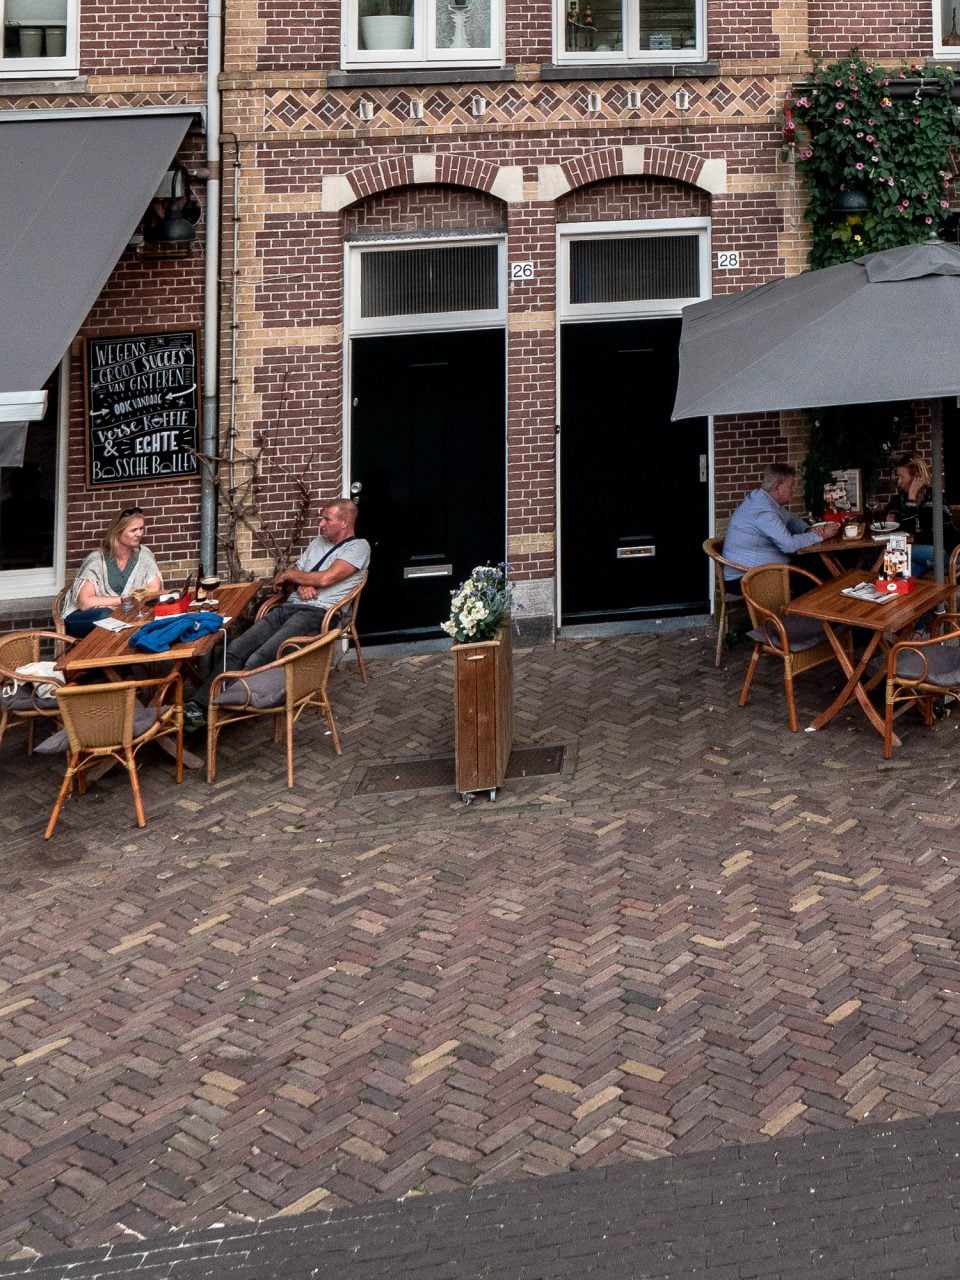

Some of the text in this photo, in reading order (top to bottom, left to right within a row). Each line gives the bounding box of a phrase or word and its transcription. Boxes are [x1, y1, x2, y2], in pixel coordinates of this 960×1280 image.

[513, 263, 533, 278] 26
[719, 253, 738, 267] 28
[95, 341, 146, 367] WEGENS
[99, 349, 186, 384] GROOT SUCCES
[108, 368, 184, 393] VAN GISTEREN
[113, 393, 163, 415] OOK VANDAAG
[97, 421, 142, 443] verse
[104, 430, 179, 457] & ECHTE
